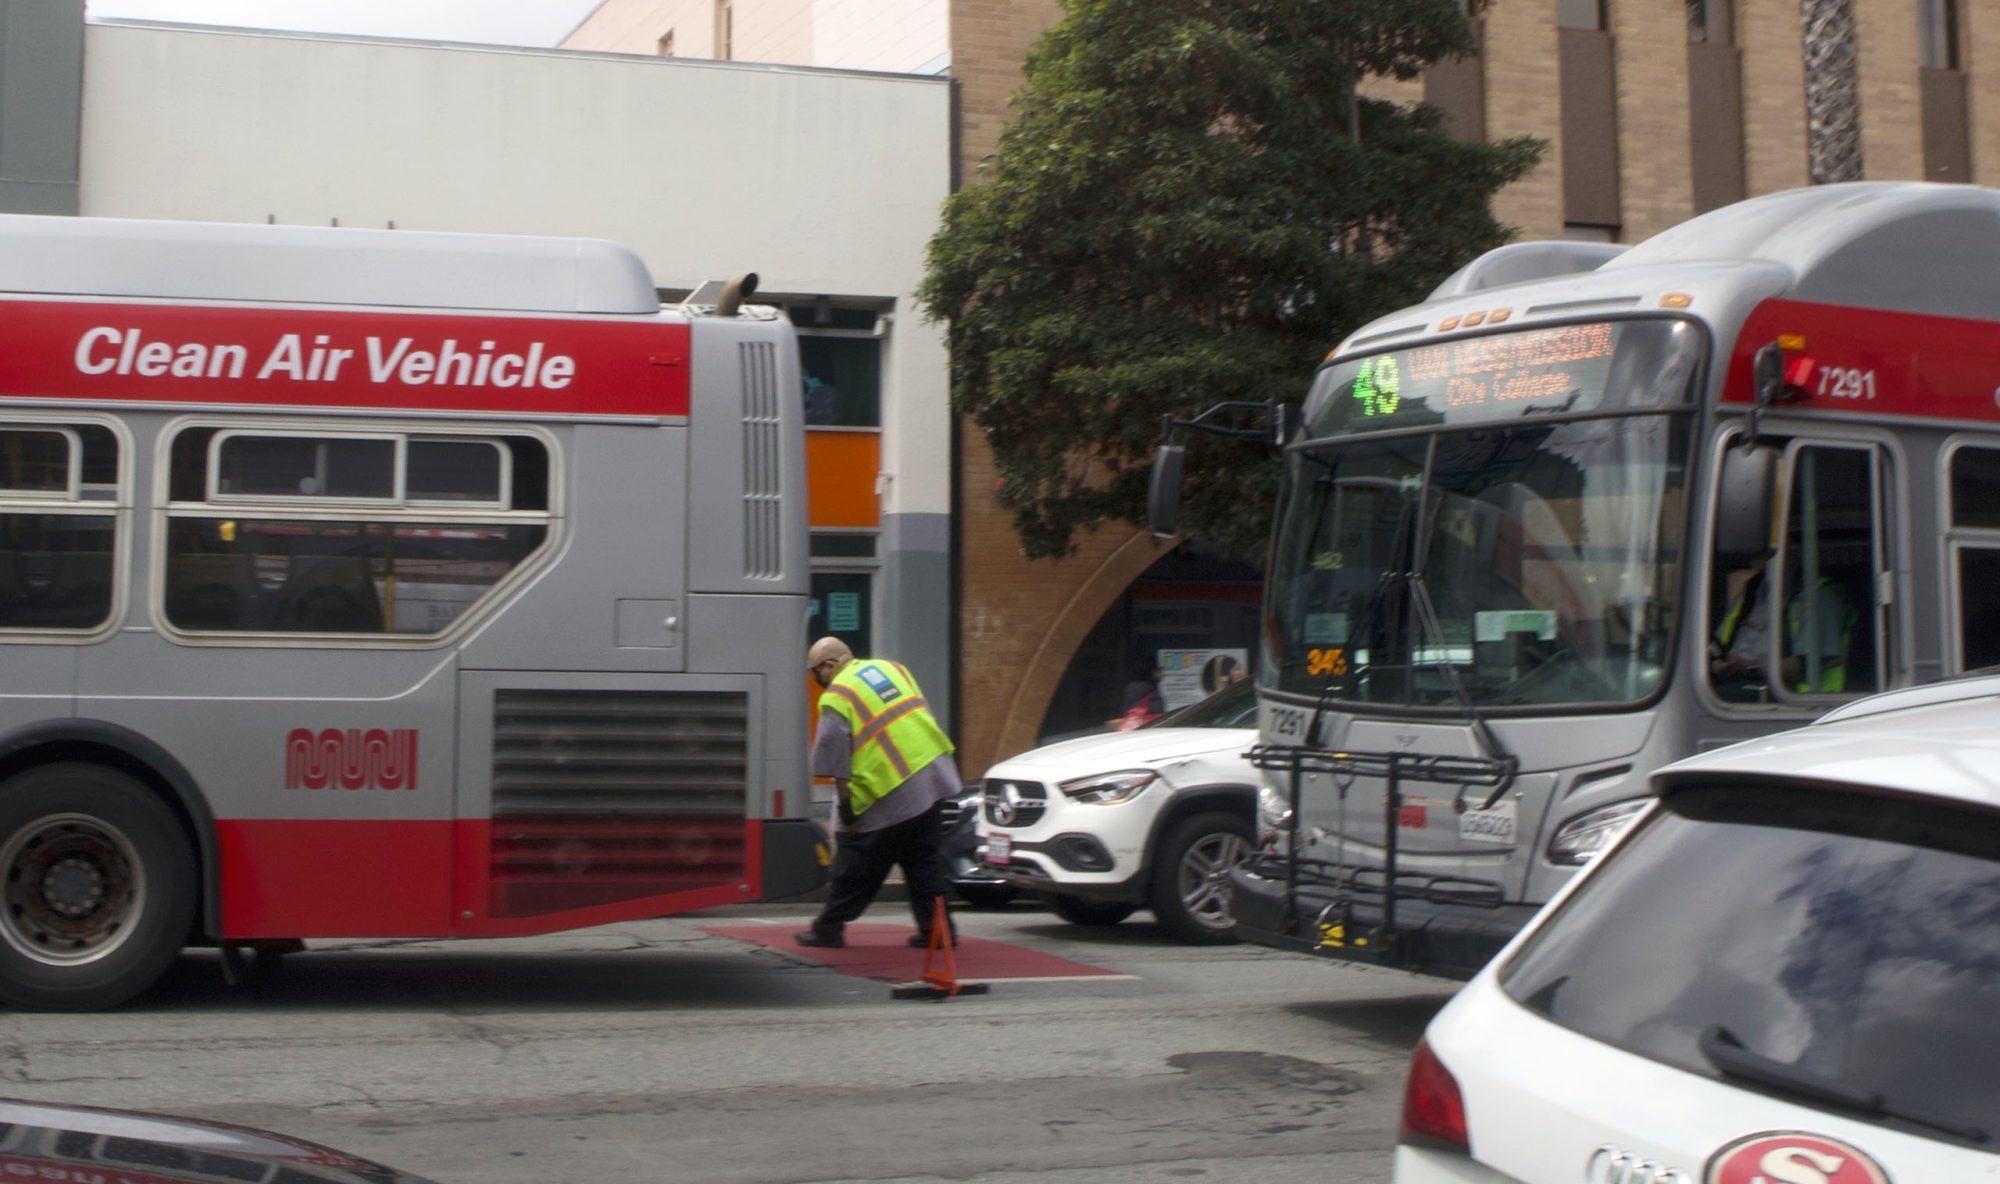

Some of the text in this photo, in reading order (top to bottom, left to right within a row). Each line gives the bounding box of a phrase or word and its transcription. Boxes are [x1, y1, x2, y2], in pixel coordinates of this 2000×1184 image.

[75, 326, 575, 390] Clean Air Vehicle
[1353, 354, 1401, 416] 49
[1817, 366, 1877, 399] 7291
[1270, 707, 1306, 737] 7291
